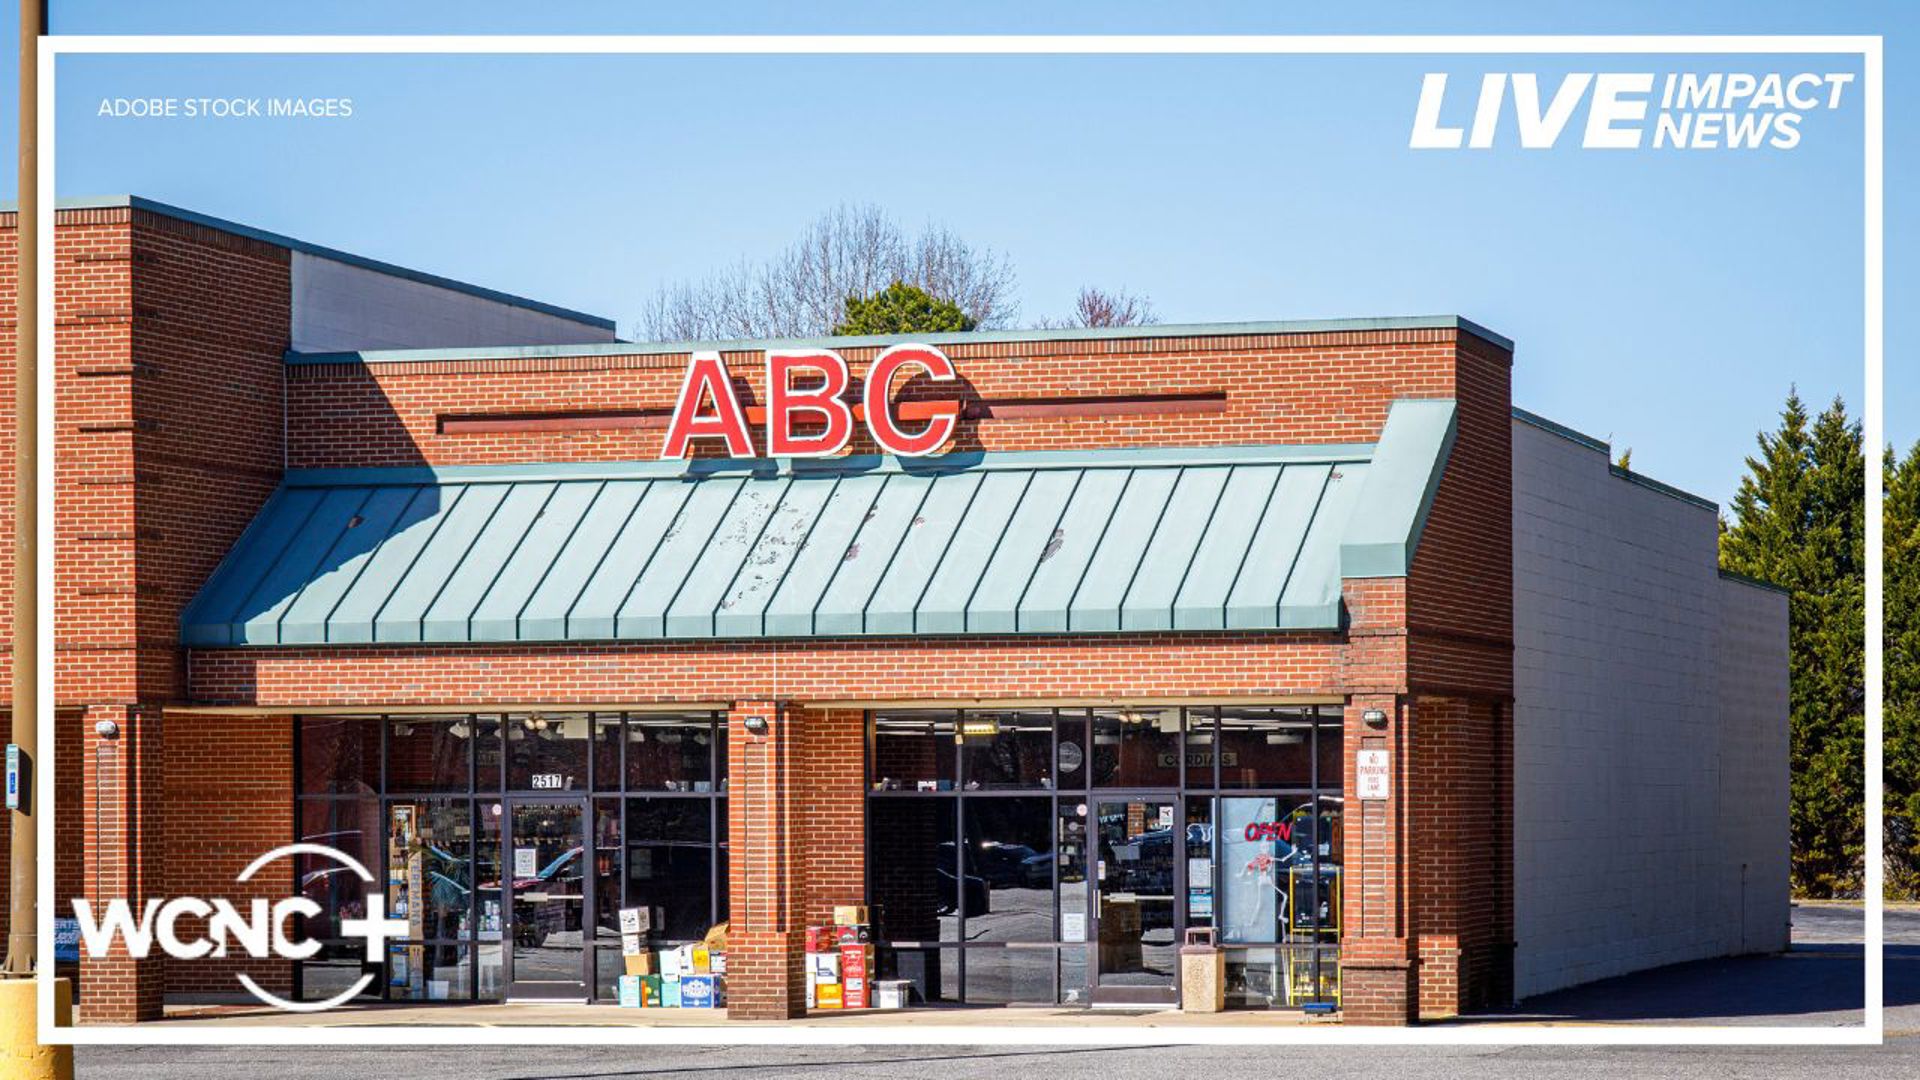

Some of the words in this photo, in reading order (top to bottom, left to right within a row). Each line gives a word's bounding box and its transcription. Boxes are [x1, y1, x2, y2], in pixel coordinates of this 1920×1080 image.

[660, 342, 958, 459] ABC
[1164, 754, 1231, 766] CRDIAS
[533, 775, 560, 788] 2517
[1245, 822, 1293, 842] OPEN
